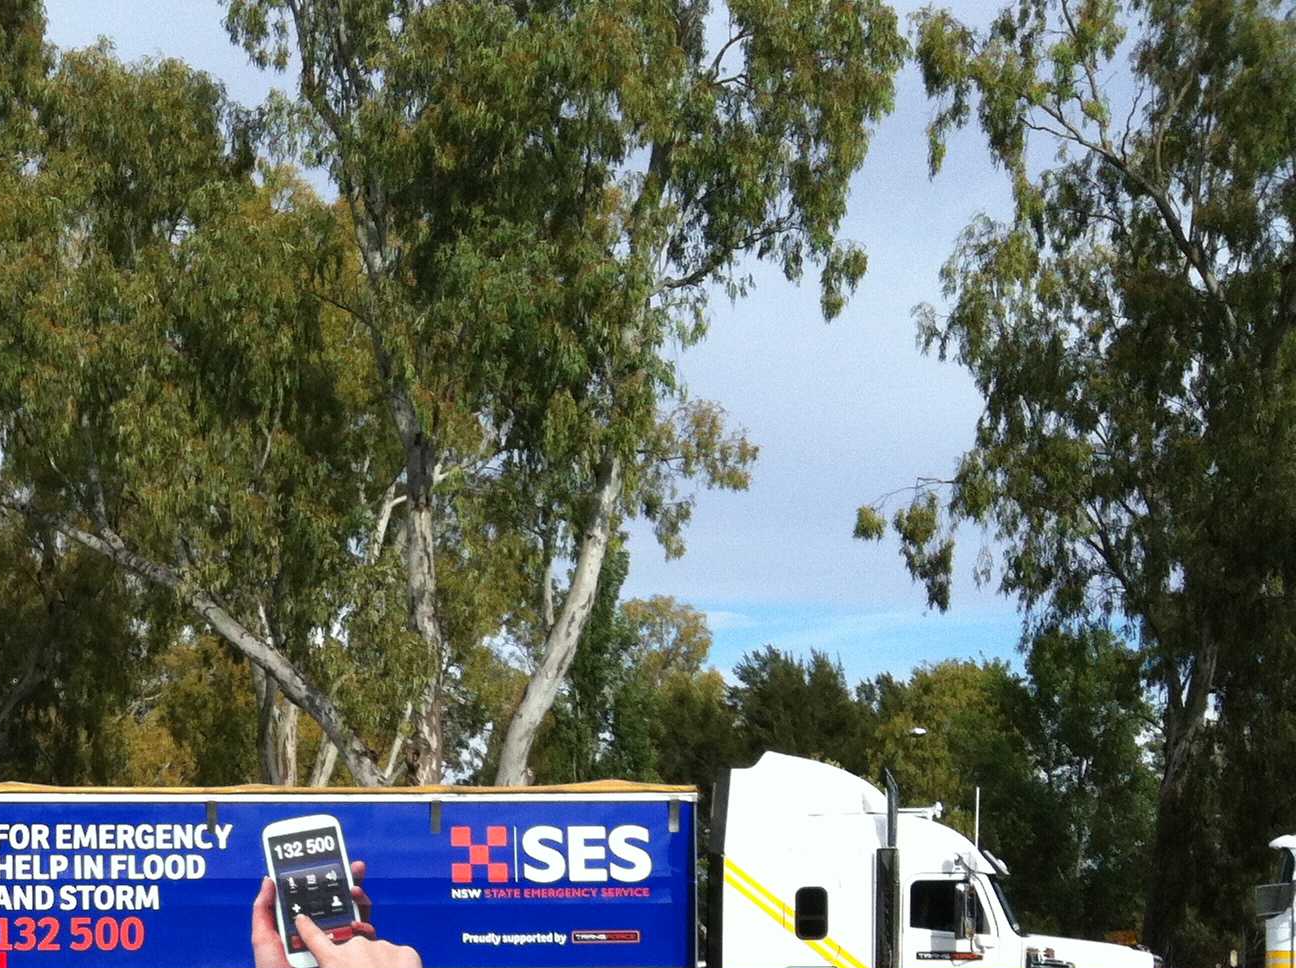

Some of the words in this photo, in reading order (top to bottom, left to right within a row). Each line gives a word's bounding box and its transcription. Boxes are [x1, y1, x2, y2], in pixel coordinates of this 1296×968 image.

[56, 824, 232, 849] EMERGENCY
[273, 841, 303, 861] 132
[306, 835, 335, 854] 500
[522, 825, 652, 883] SES
[74, 855, 104, 880] IN
[110, 854, 206, 880] FLOOD
[60, 885, 159, 910] STORM
[451, 889, 481, 898] NSW
[484, 888, 520, 897] STATE
[524, 888, 597, 898] EMERGENCY
[601, 888, 650, 898] SERVICE
[70, 917, 144, 951] 500
[463, 933, 501, 945] Proudly
[502, 933, 551, 945] supported
[552, 933, 567, 945] by
